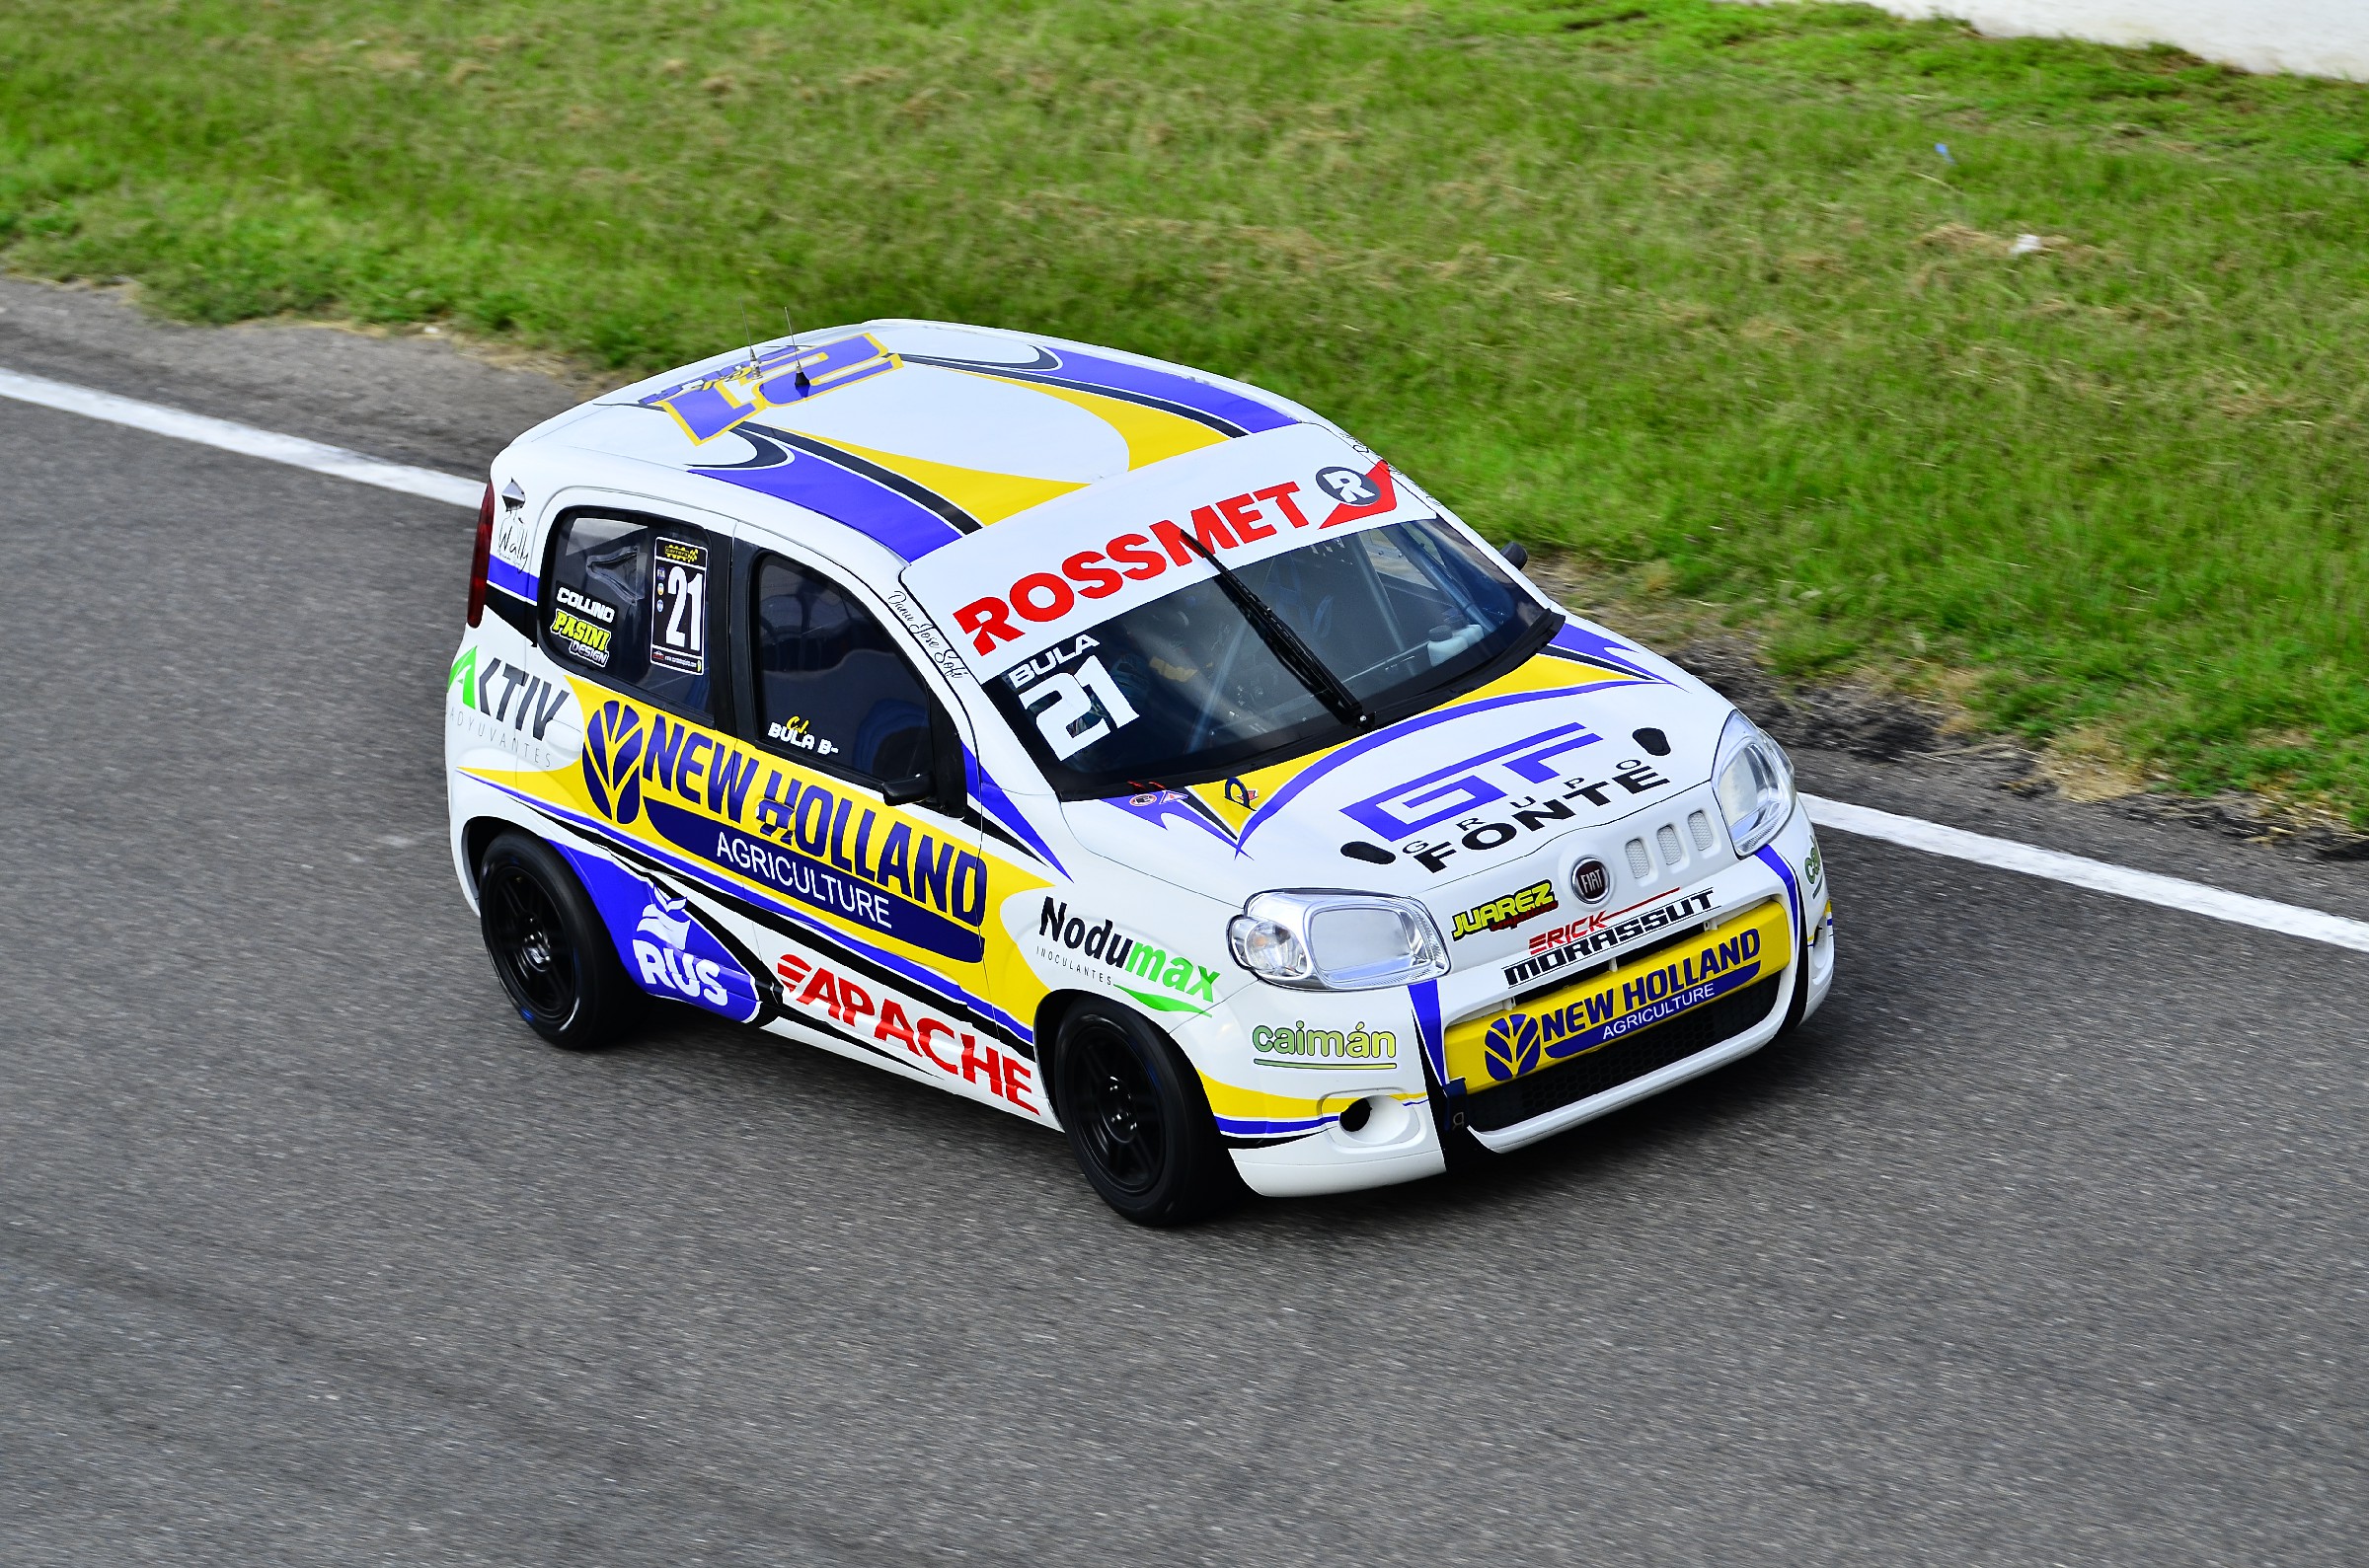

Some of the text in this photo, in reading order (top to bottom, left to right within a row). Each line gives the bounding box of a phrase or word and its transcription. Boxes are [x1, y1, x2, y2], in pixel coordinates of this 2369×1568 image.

[954, 481, 1310, 656] ROSSMET
[552, 610, 610, 651] PASINI
[557, 587, 615, 624] COLLINO
[666, 565, 703, 651] 21
[572, 639, 608, 664] DESIGN
[1007, 634, 1100, 689] BULA
[449, 707, 551, 768] ADYUVANTES
[768, 721, 815, 751] BULA
[1019, 655, 1139, 761] 21
[643, 714, 988, 927] NEW HOLLAND
[1403, 759, 1642, 855] GRUPO
[1414, 766, 1670, 873] FONTE
[716, 830, 893, 929] AGRICULTURE
[1452, 882, 1555, 938] JUAREZ
[1581, 876, 1602, 894] FIAT
[1039, 896, 1221, 1003] Nodumax
[1503, 890, 1715, 988] MORASSUT
[1529, 910, 1607, 955] ERICK
[632, 938, 728, 1007] RUS
[1035, 945, 1113, 987] INOCULANTES
[1540, 928, 1761, 1041] NEW HOLLAND
[797, 971, 1041, 1116] APACHE
[1253, 1020, 1397, 1062] caimán
[1602, 983, 1716, 1040] AGRICULTURE
